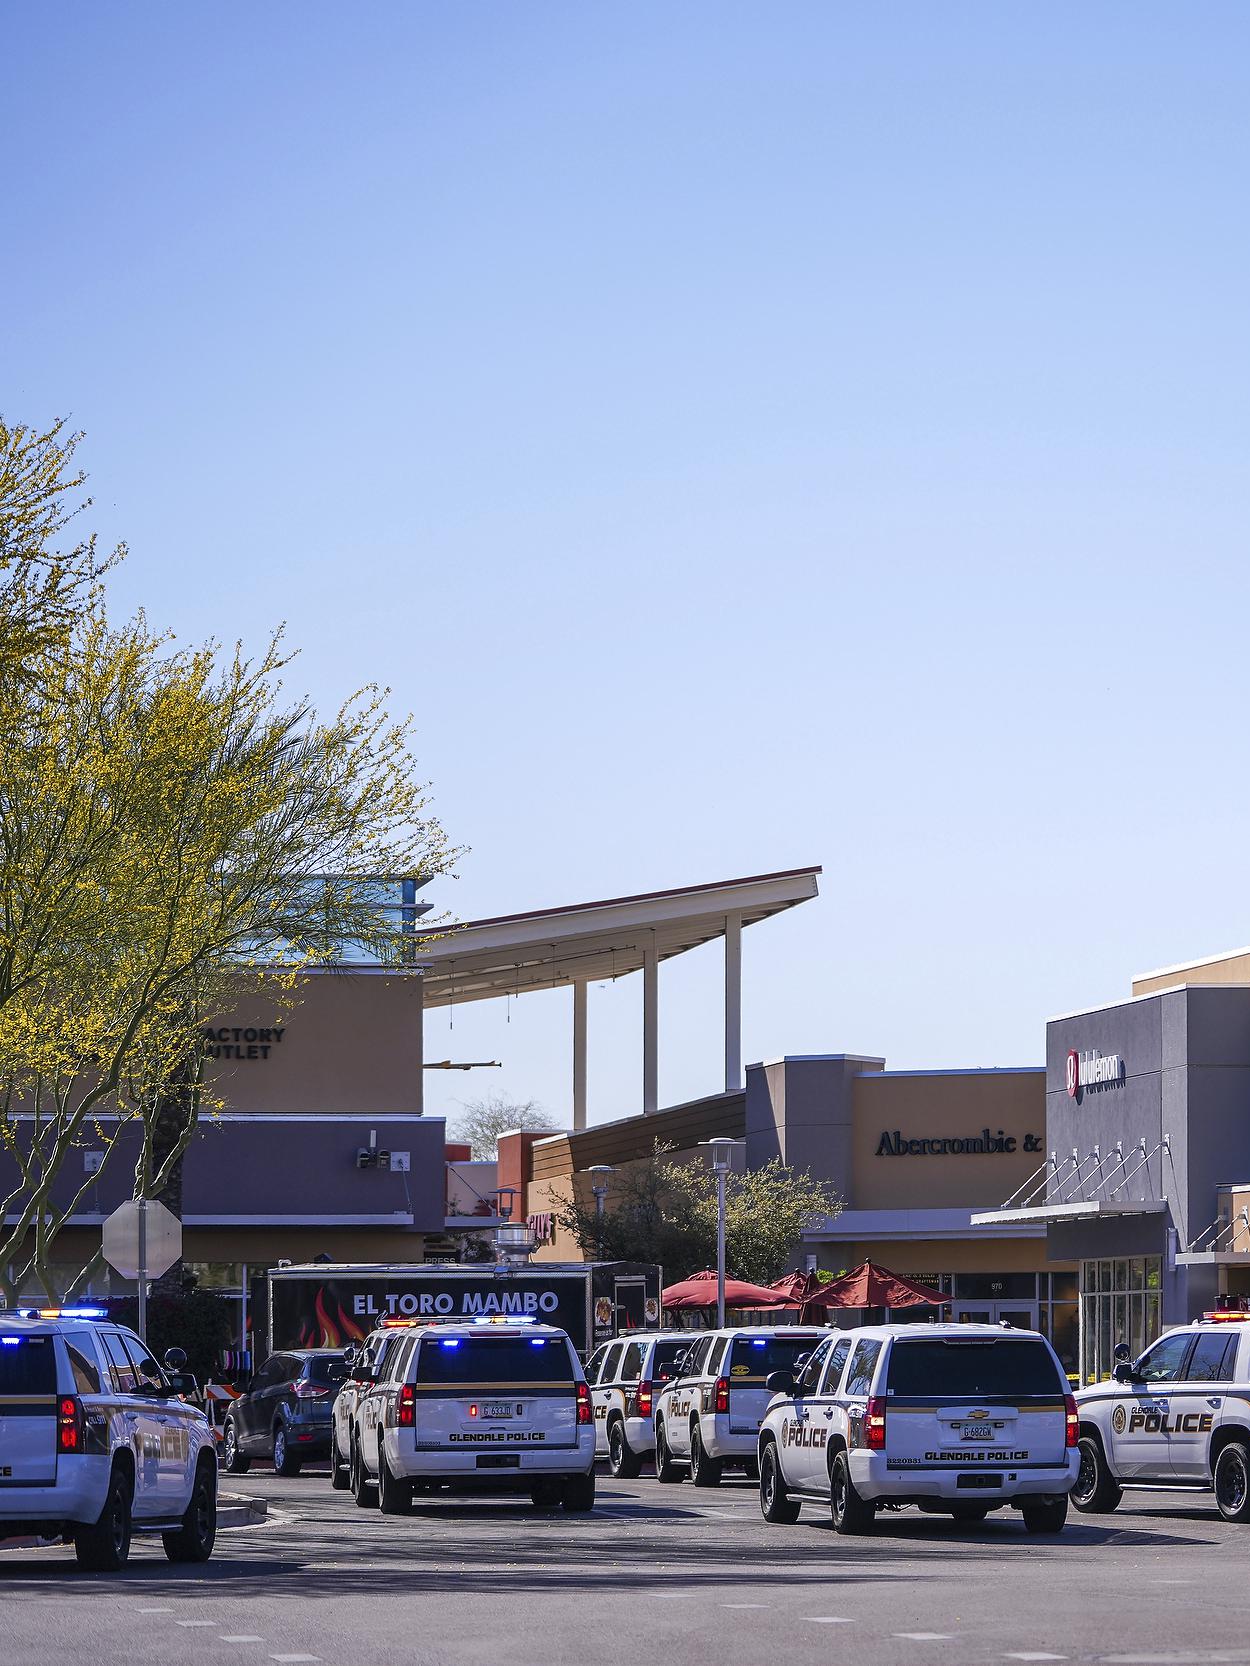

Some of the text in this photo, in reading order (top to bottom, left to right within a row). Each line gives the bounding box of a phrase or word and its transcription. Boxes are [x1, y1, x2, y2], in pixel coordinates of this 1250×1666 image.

[201, 1027, 286, 1043] ACTORY
[205, 1044, 272, 1060] UTLET
[1077, 1049, 1120, 1086] lululemon
[875, 1128, 1043, 1156] Abercrombie &
[991, 1282, 1003, 1291] 970
[353, 1291, 559, 1315] EL TORO MAMBO
[1128, 1413, 1215, 1433] POLICE
[449, 1432, 546, 1442] GLENDALE POLICE
[788, 1427, 828, 1448] POLICE
[925, 1450, 1029, 1461] GLENDALE POLICE
